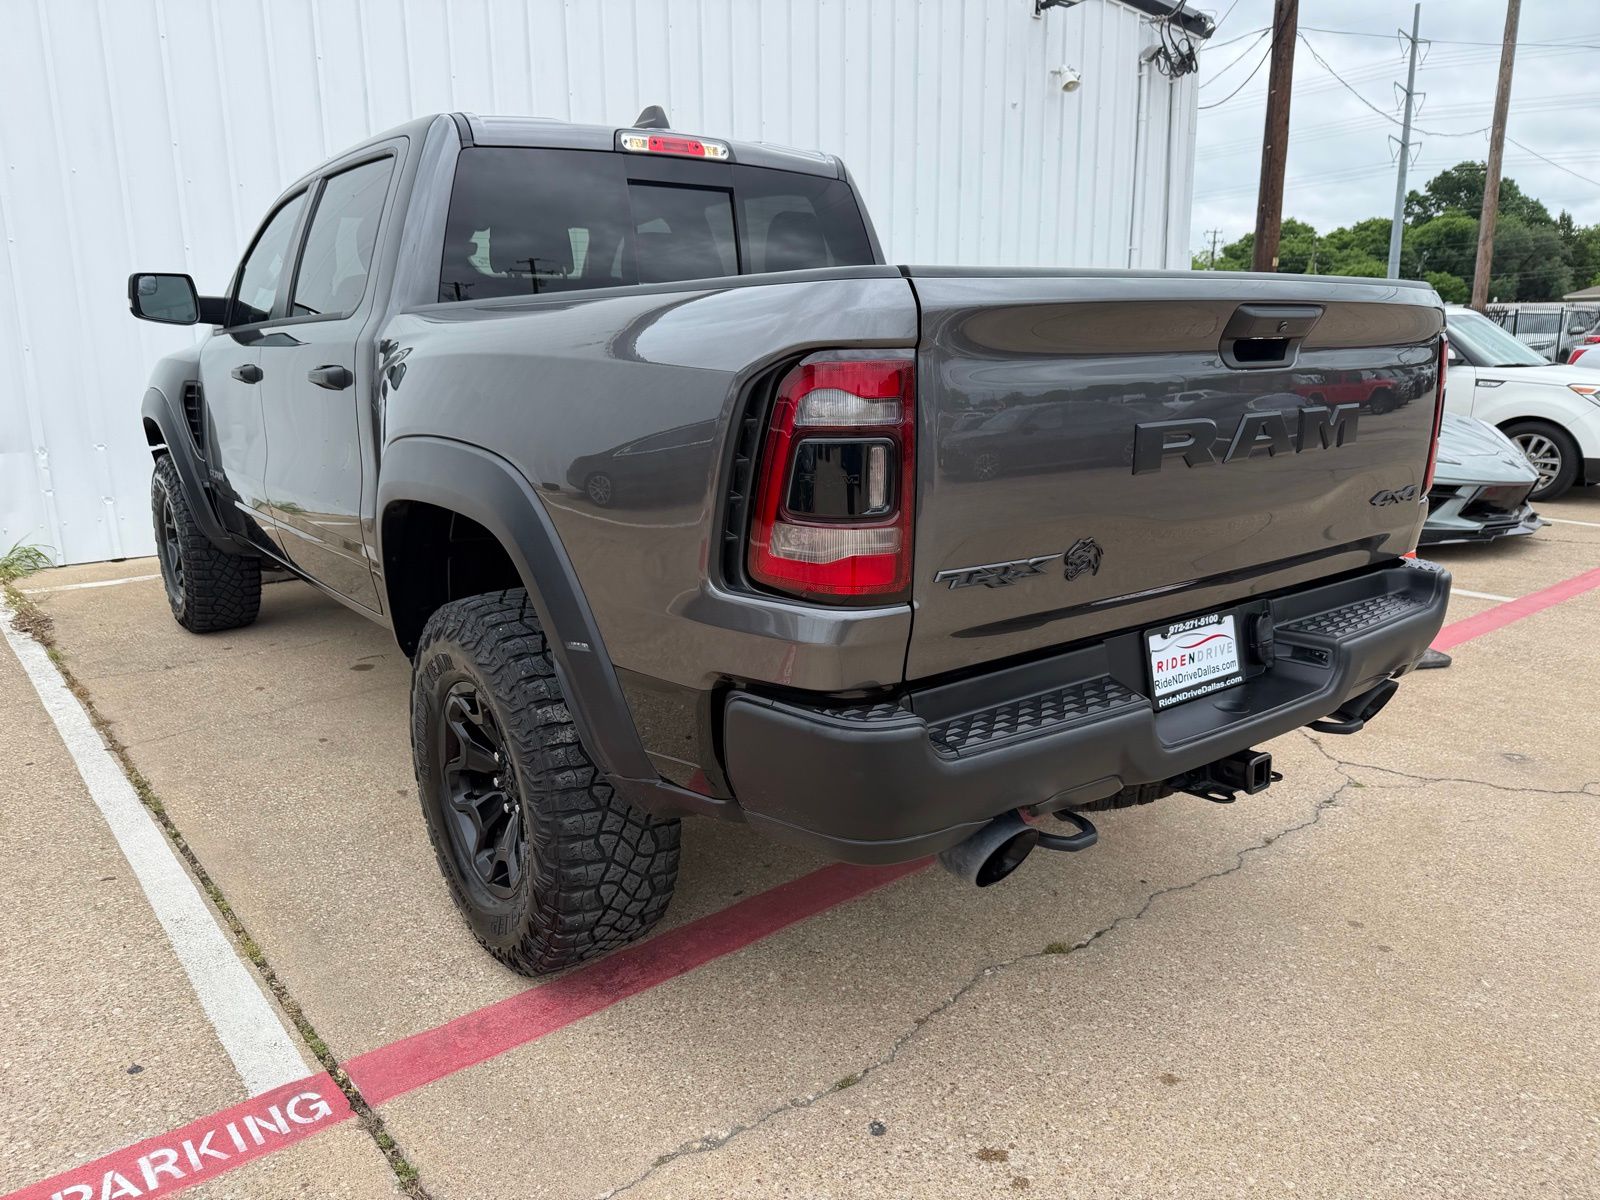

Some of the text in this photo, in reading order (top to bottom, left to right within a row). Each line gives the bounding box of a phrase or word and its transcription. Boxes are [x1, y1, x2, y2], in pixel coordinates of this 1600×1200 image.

[1132, 403, 1360, 475] RAM
[933, 553, 1064, 589] TRX
[1168, 614, 1219, 634] 972-271-5100
[1154, 659, 1237, 691] RideNDriveDallas.com
[1158, 676, 1243, 708] RideNDriveDallas.com
